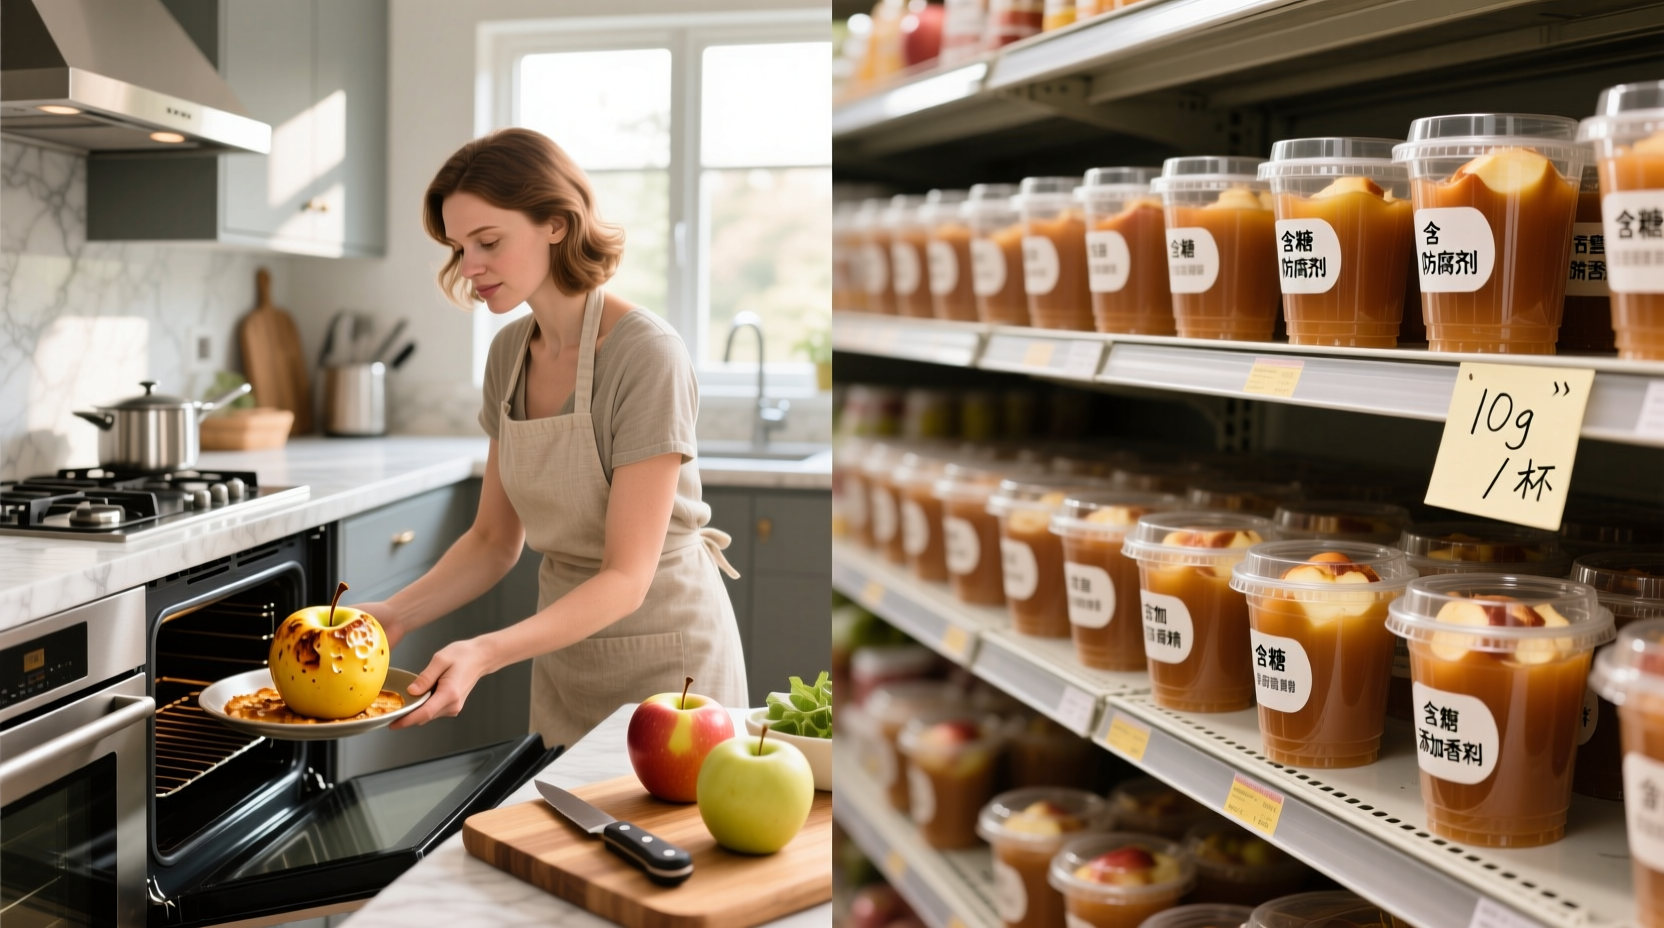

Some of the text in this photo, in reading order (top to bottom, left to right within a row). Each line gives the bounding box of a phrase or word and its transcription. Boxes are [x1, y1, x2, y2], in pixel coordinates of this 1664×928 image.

[1281, 229, 1314, 253] 含糖
[1423, 220, 1441, 246] 含
[1421, 249, 1478, 276] 防腐剂
[1470, 388, 1534, 451] 10g
[1255, 643, 1286, 672] 含糖
[1423, 700, 1460, 733] 含糖
